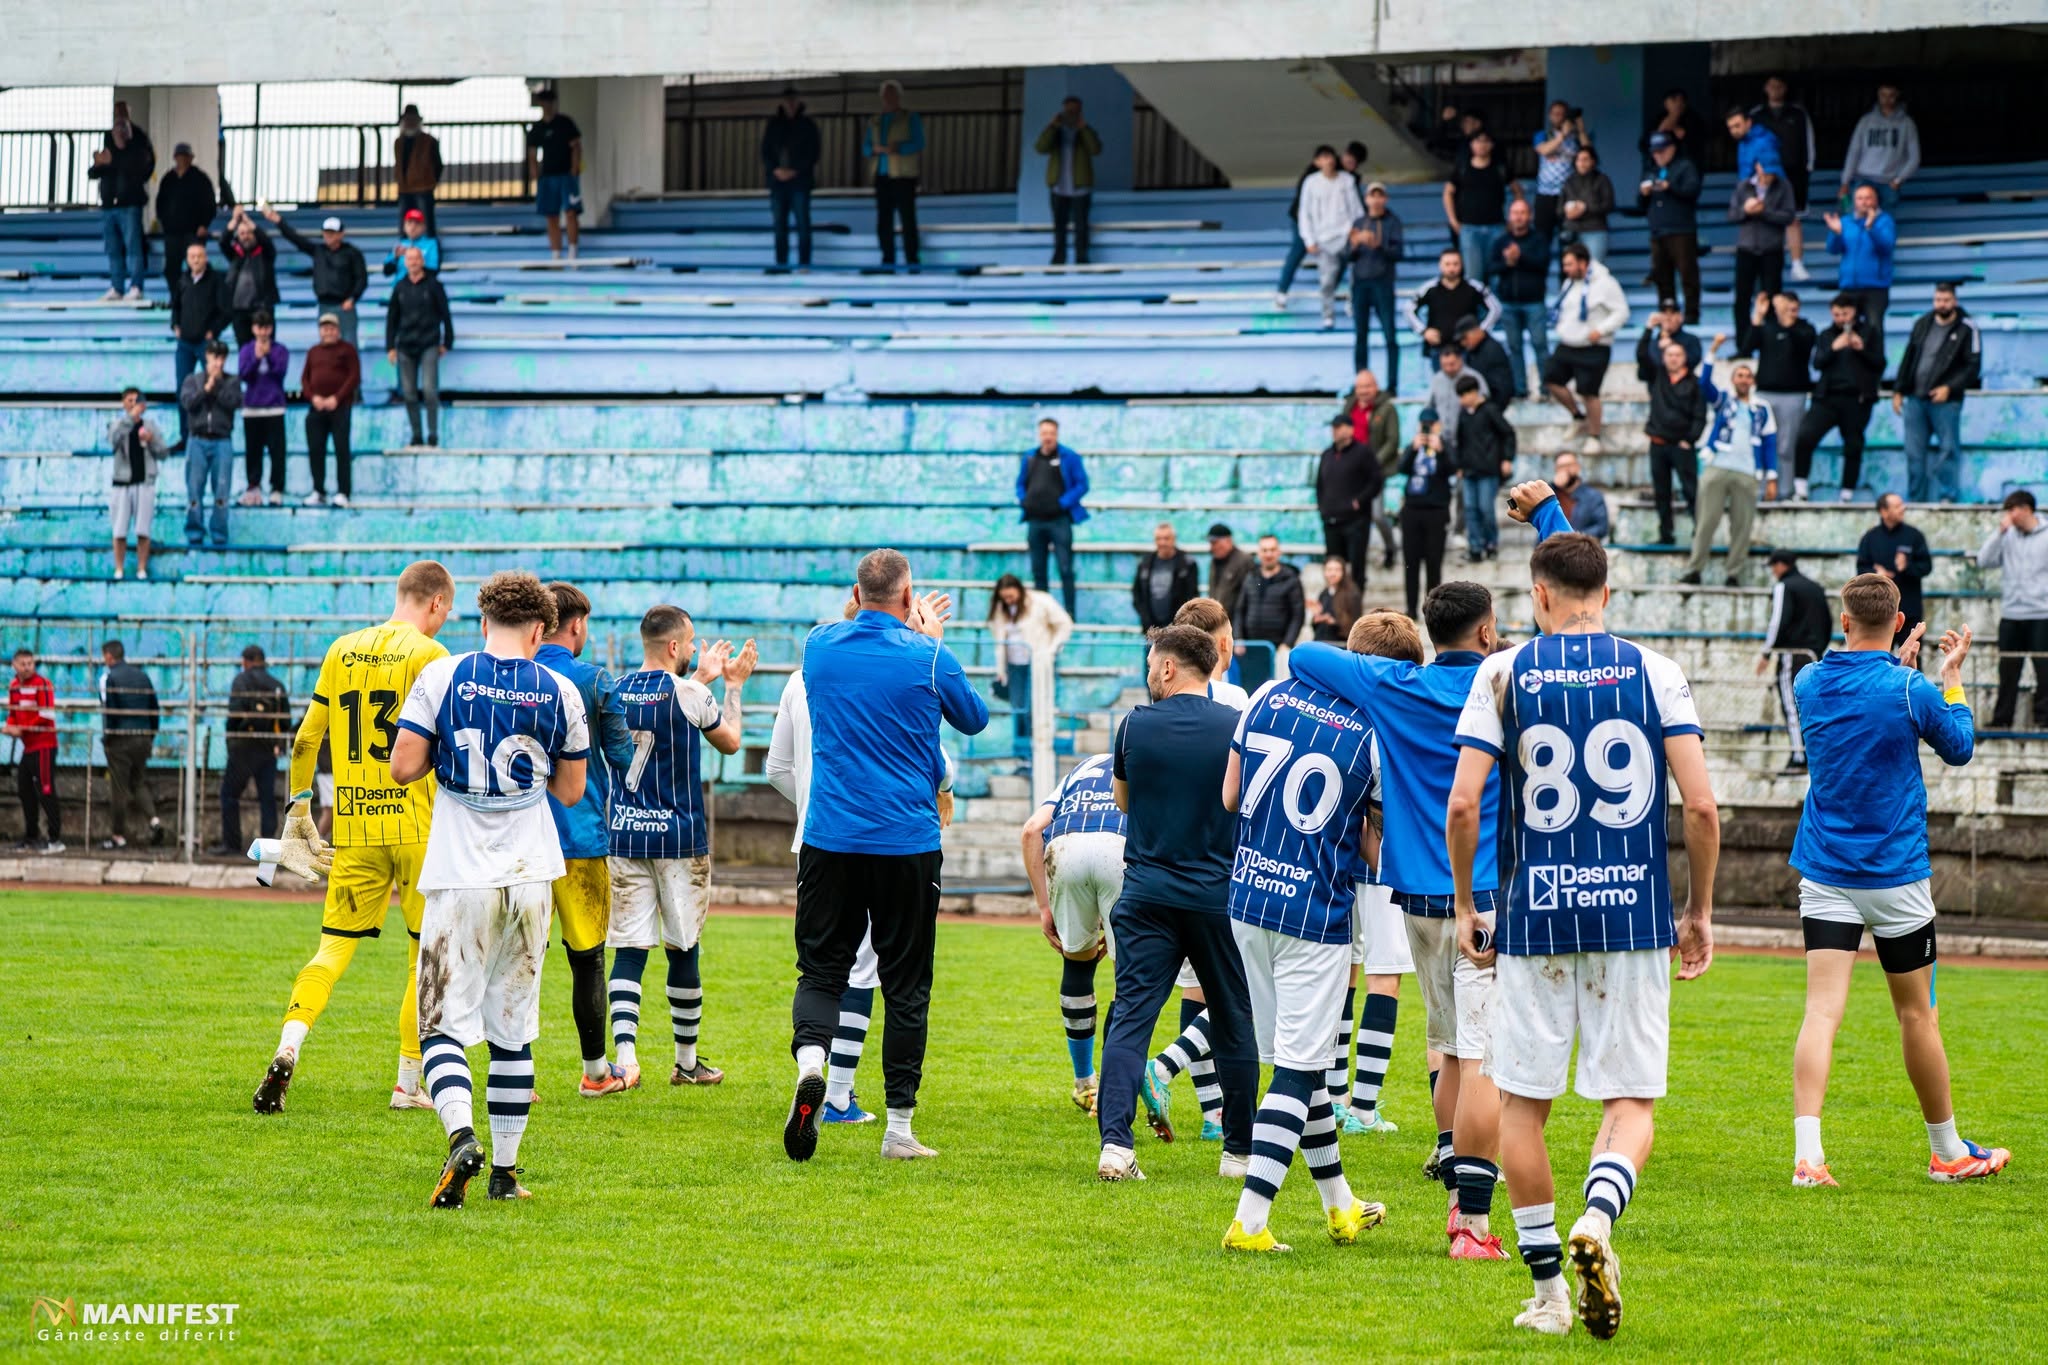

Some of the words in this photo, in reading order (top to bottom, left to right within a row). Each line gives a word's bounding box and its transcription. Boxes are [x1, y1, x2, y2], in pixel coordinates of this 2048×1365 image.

[1543, 666, 1637, 684] SERGROUP
[478, 685, 553, 704] SERGROUP
[619, 692, 668, 702] ERGROUP
[1287, 696, 1363, 732] SERGROUP
[339, 690, 398, 764] 13
[453, 728, 551, 796] 10
[625, 730, 655, 793] 7
[1239, 732, 1344, 834] 70
[1517, 718, 1656, 833] 89
[355, 787, 409, 801] Dasmar
[1081, 790, 1114, 801] Das
[355, 803, 404, 816] Termo
[626, 806, 673, 820] Dasmar
[1080, 801, 1120, 812] Term
[626, 819, 668, 832] Termo
[1250, 850, 1313, 882] Dasmar
[1560, 864, 1648, 885] Dasmar
[1247, 868, 1297, 898] Termo
[1560, 887, 1638, 909] Termo
